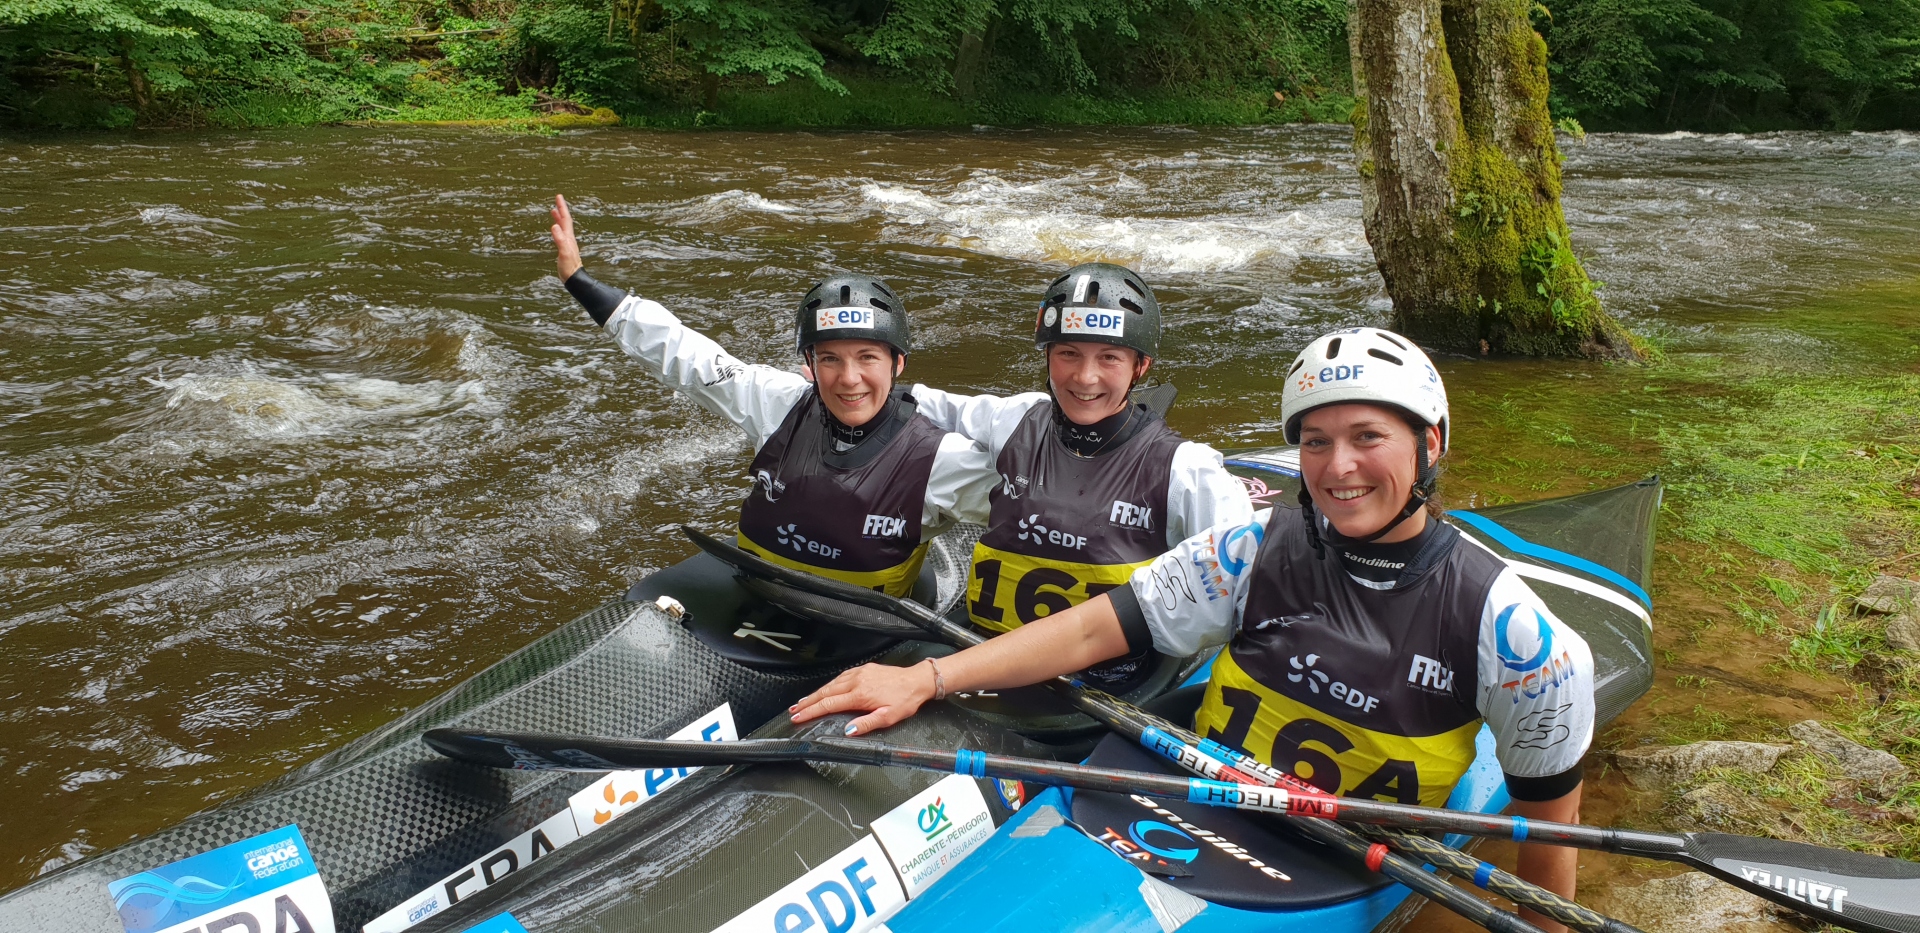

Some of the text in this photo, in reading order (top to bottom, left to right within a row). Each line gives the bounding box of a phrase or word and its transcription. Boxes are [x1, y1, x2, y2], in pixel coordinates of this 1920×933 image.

[862, 514, 907, 538] FFCK
[1109, 500, 1152, 529] FFCK
[1192, 533, 1229, 601] TEAM
[1343, 551, 1405, 570] sandiline
[970, 558, 1122, 625] 16
[1502, 651, 1575, 704] TEAM
[1207, 685, 1421, 805] 16A
[243, 836, 294, 860] international
[247, 844, 300, 871] canoe
[912, 828, 987, 885] BANQUE ET ASSURANCES
[253, 857, 304, 880] federation
[408, 900, 438, 922] canoe
